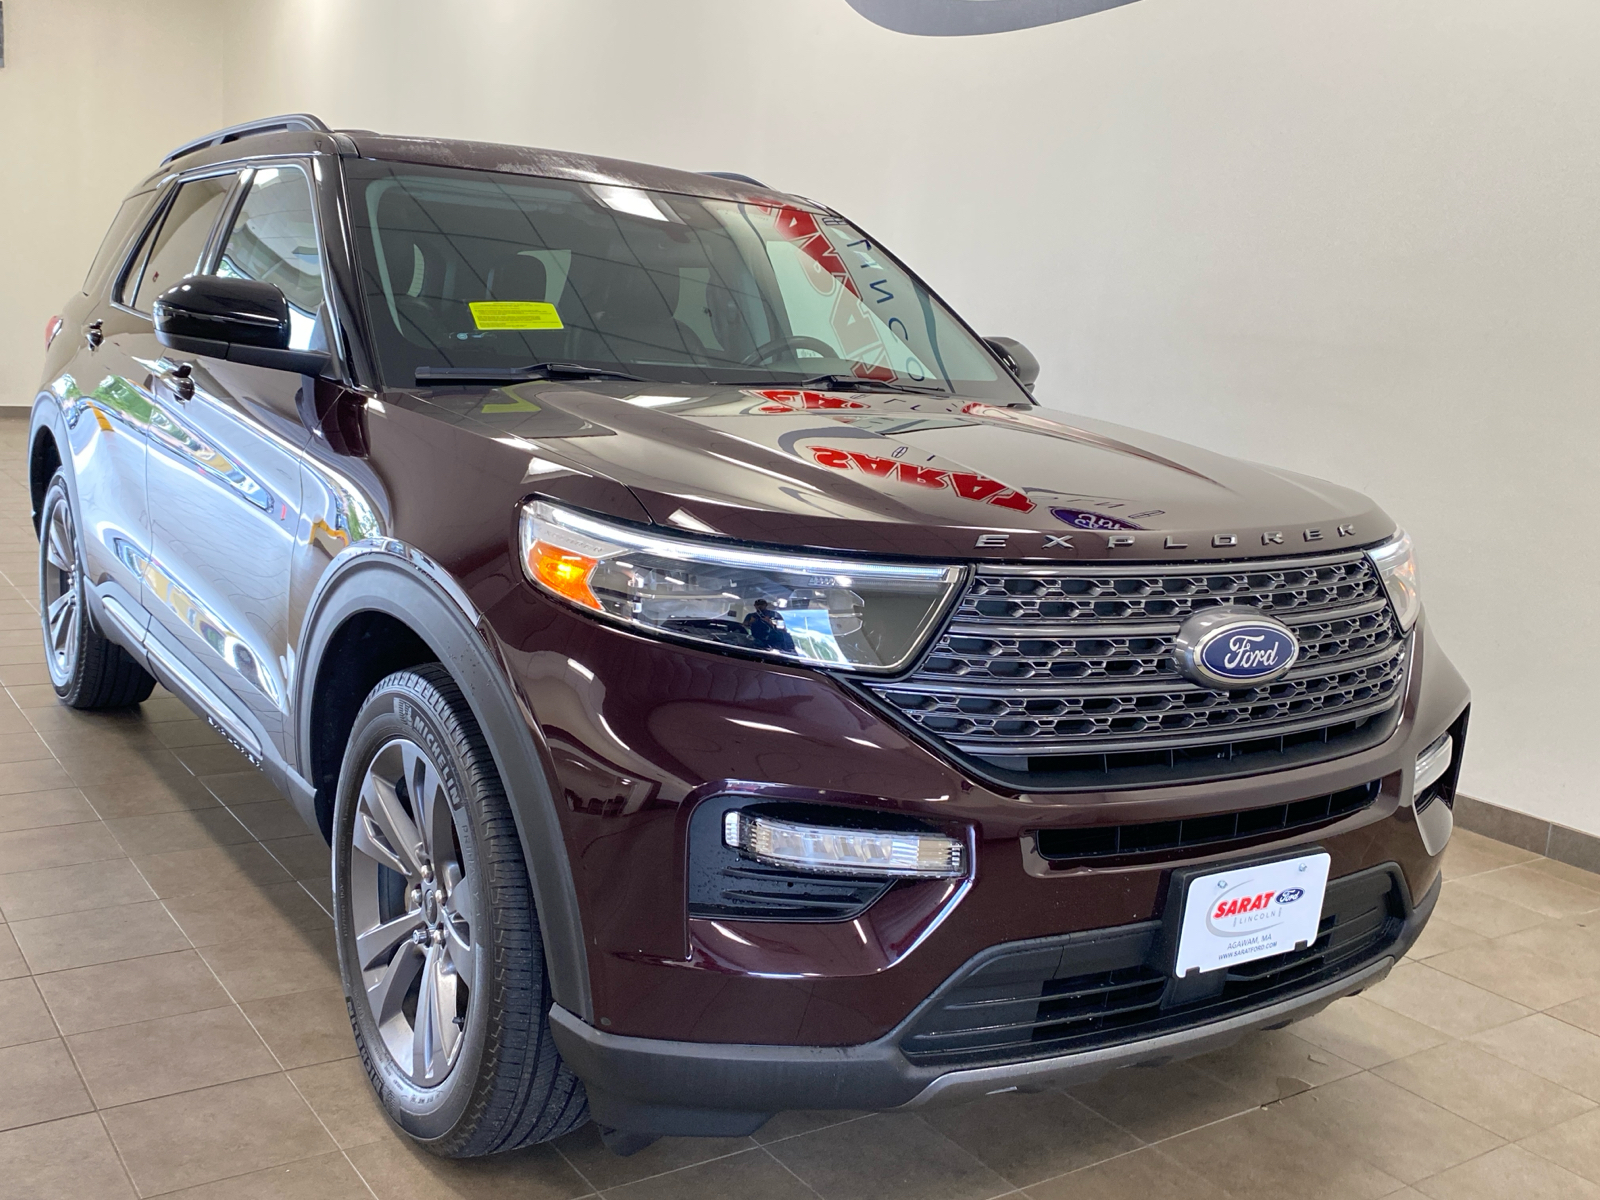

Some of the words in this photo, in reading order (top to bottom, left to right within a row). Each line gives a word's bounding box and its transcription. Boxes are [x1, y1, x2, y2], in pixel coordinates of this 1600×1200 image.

[974, 523, 1357, 550] EXPLORER
[1224, 635, 1279, 669] Ford
[413, 715, 461, 805] MICHELIN
[1214, 891, 1276, 918] SARAT
[1279, 888, 1301, 903] Ford
[1239, 910, 1276, 925] LINCOLN
[1218, 941, 1278, 960] WWW.SARATFORD.COM
[1261, 933, 1272, 942] MA
